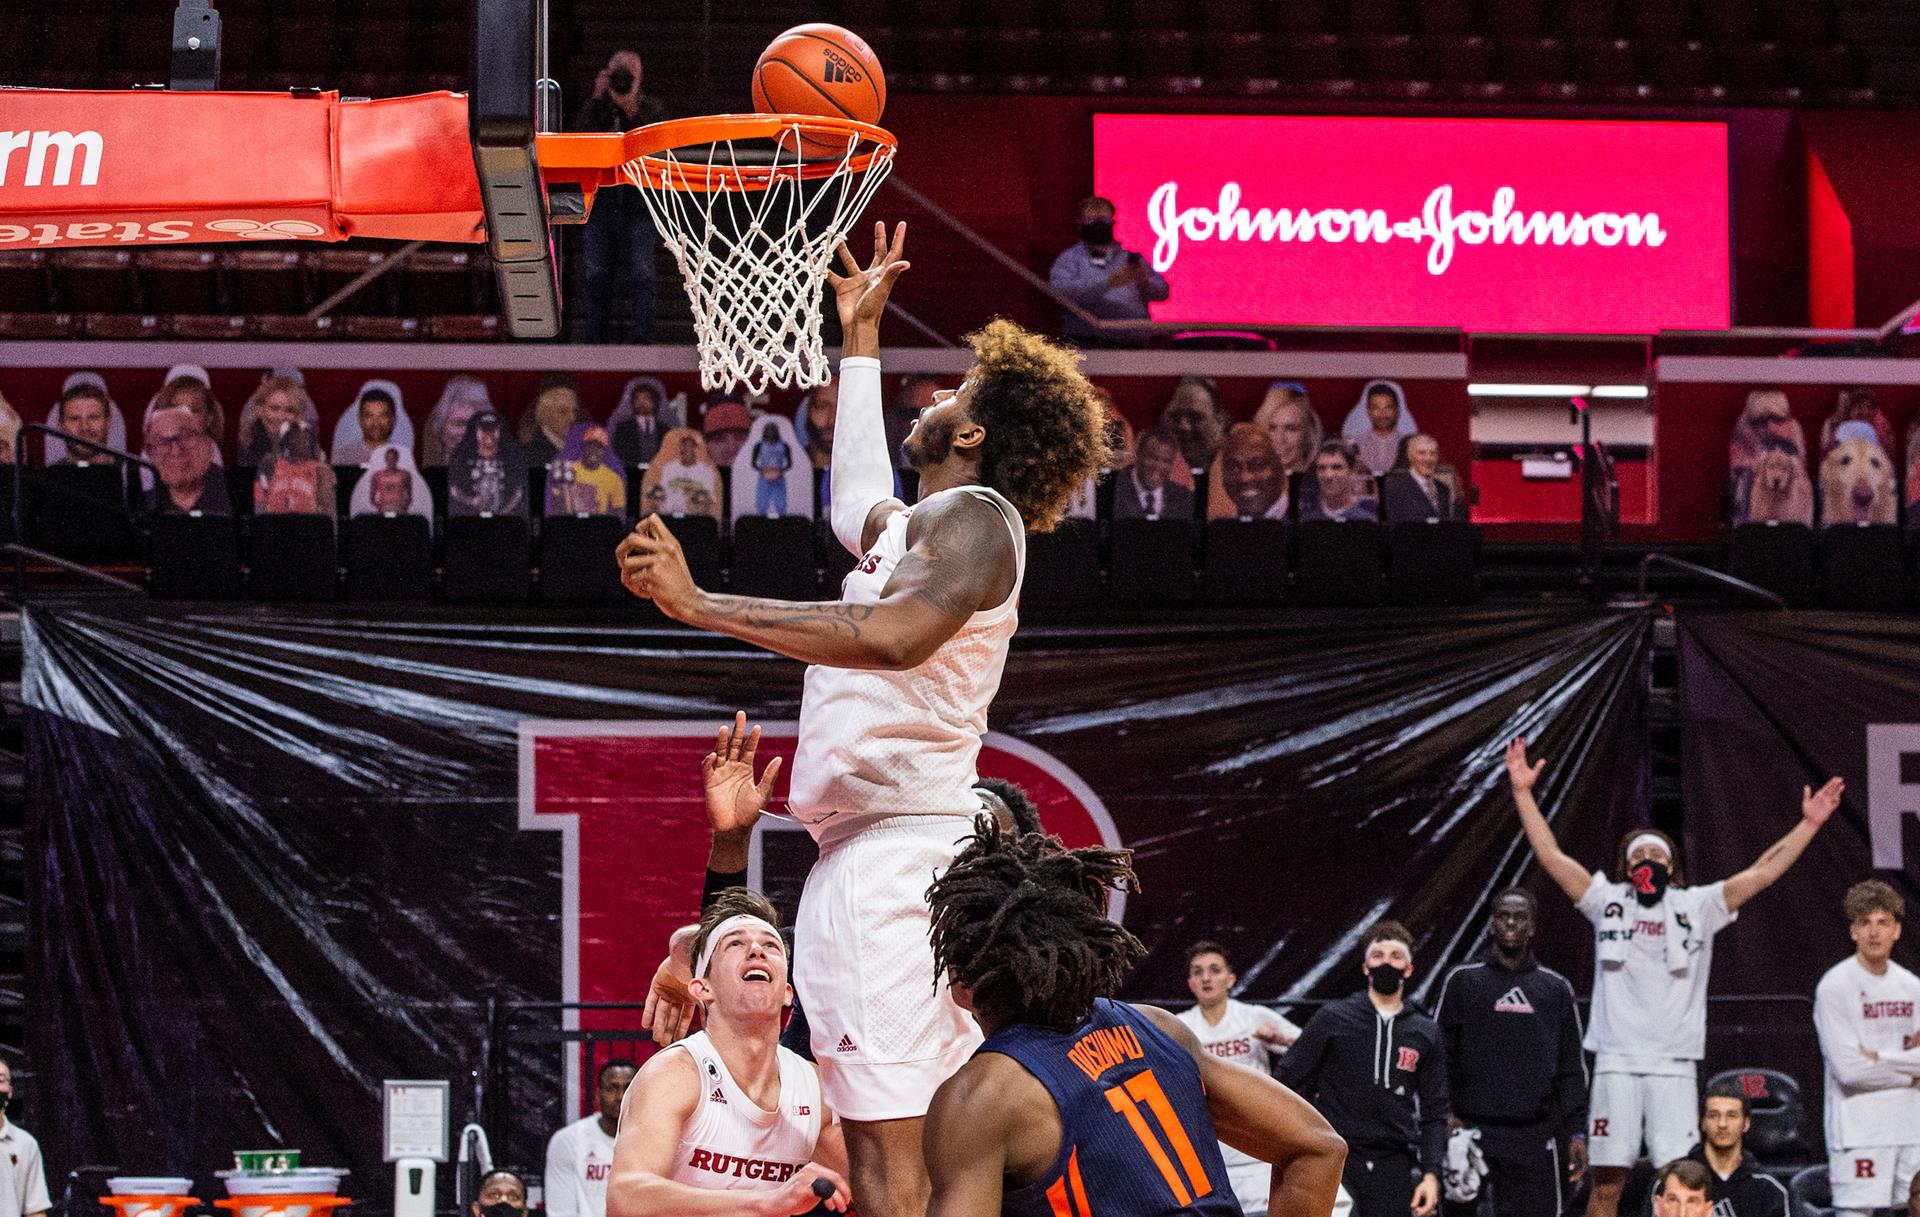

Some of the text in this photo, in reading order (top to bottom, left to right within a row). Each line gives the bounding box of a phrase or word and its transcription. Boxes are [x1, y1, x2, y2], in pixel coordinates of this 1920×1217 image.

[823, 48, 862, 82] adidas
[0, 219, 194, 245] State
[1104, 1069, 1212, 1208] 11
[1592, 1118, 1609, 1137] R
[1855, 1159, 1875, 1178] R
